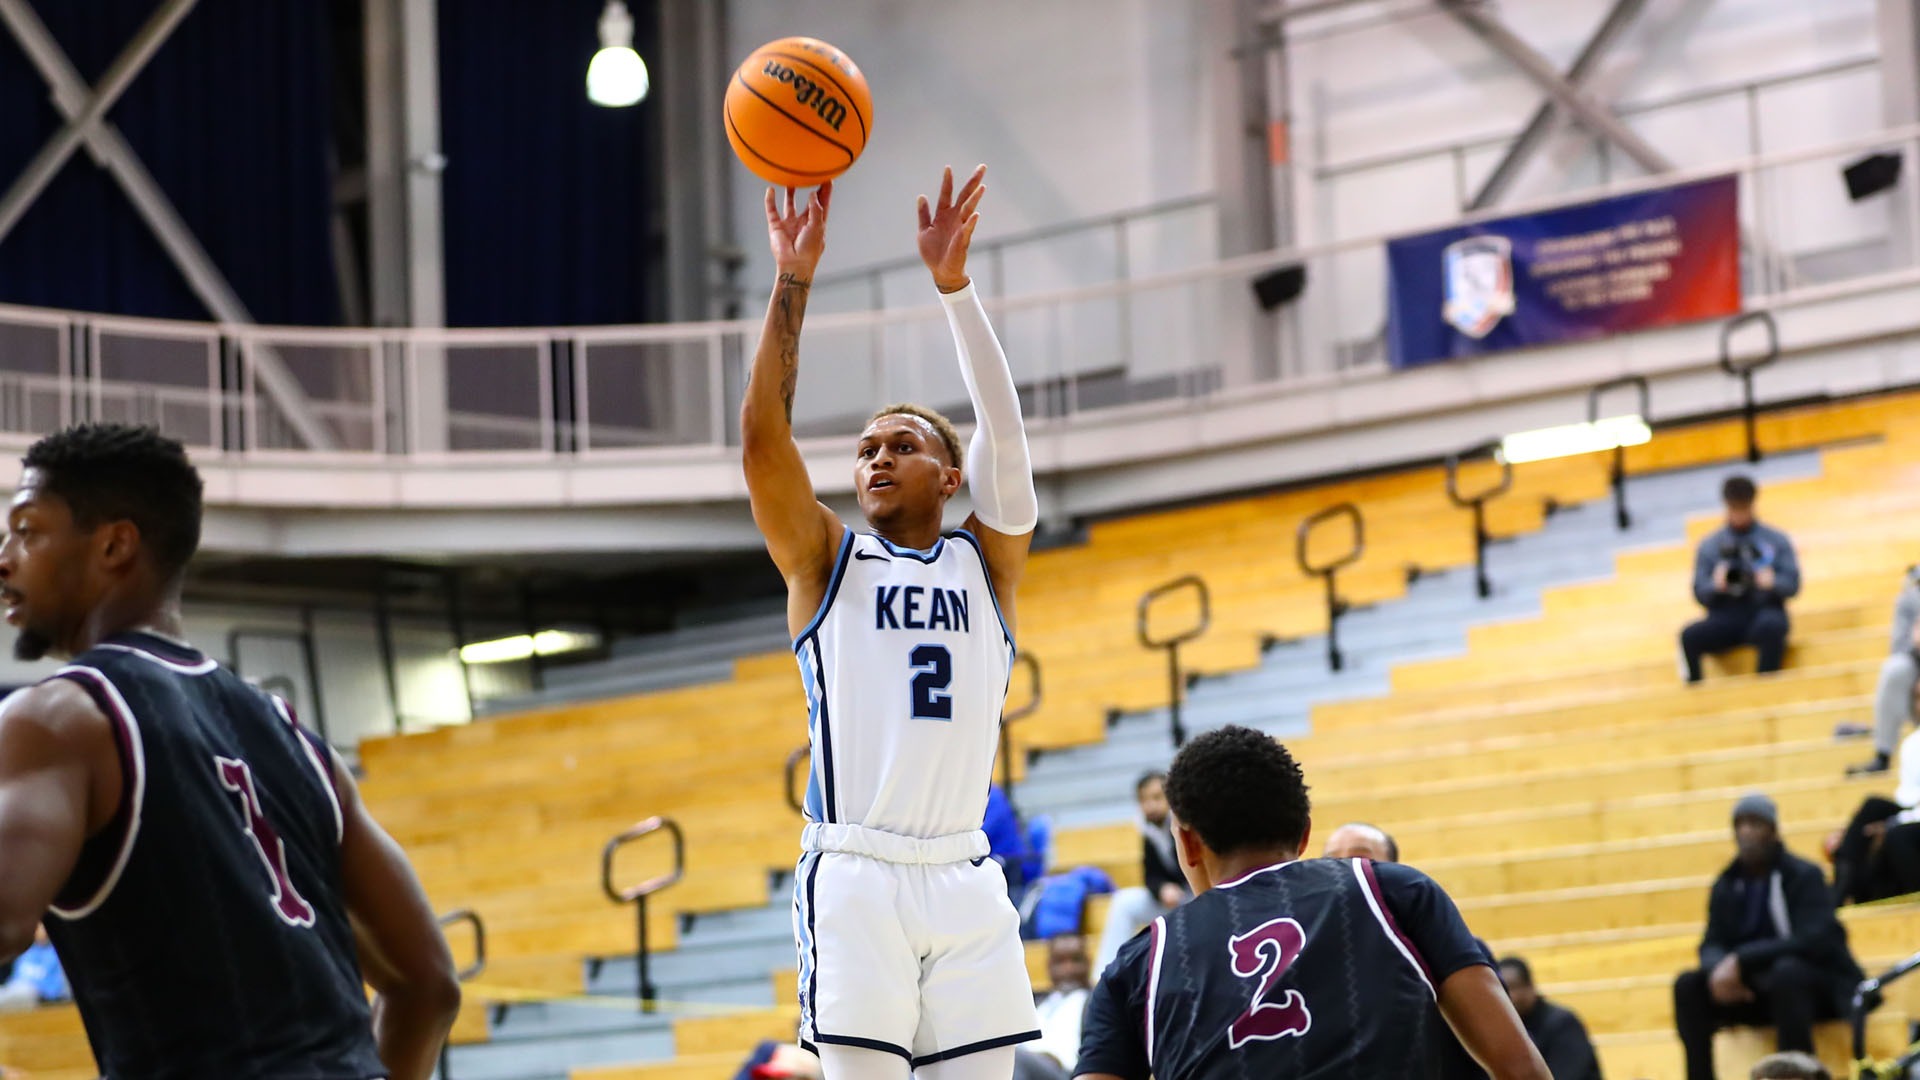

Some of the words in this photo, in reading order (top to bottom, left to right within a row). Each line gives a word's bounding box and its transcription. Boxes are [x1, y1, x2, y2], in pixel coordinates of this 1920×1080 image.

[763, 59, 847, 132] Wilson
[875, 585, 970, 633] KEAN
[909, 643, 952, 722] 2
[214, 755, 316, 929] 1
[1228, 917, 1312, 1050] 2
